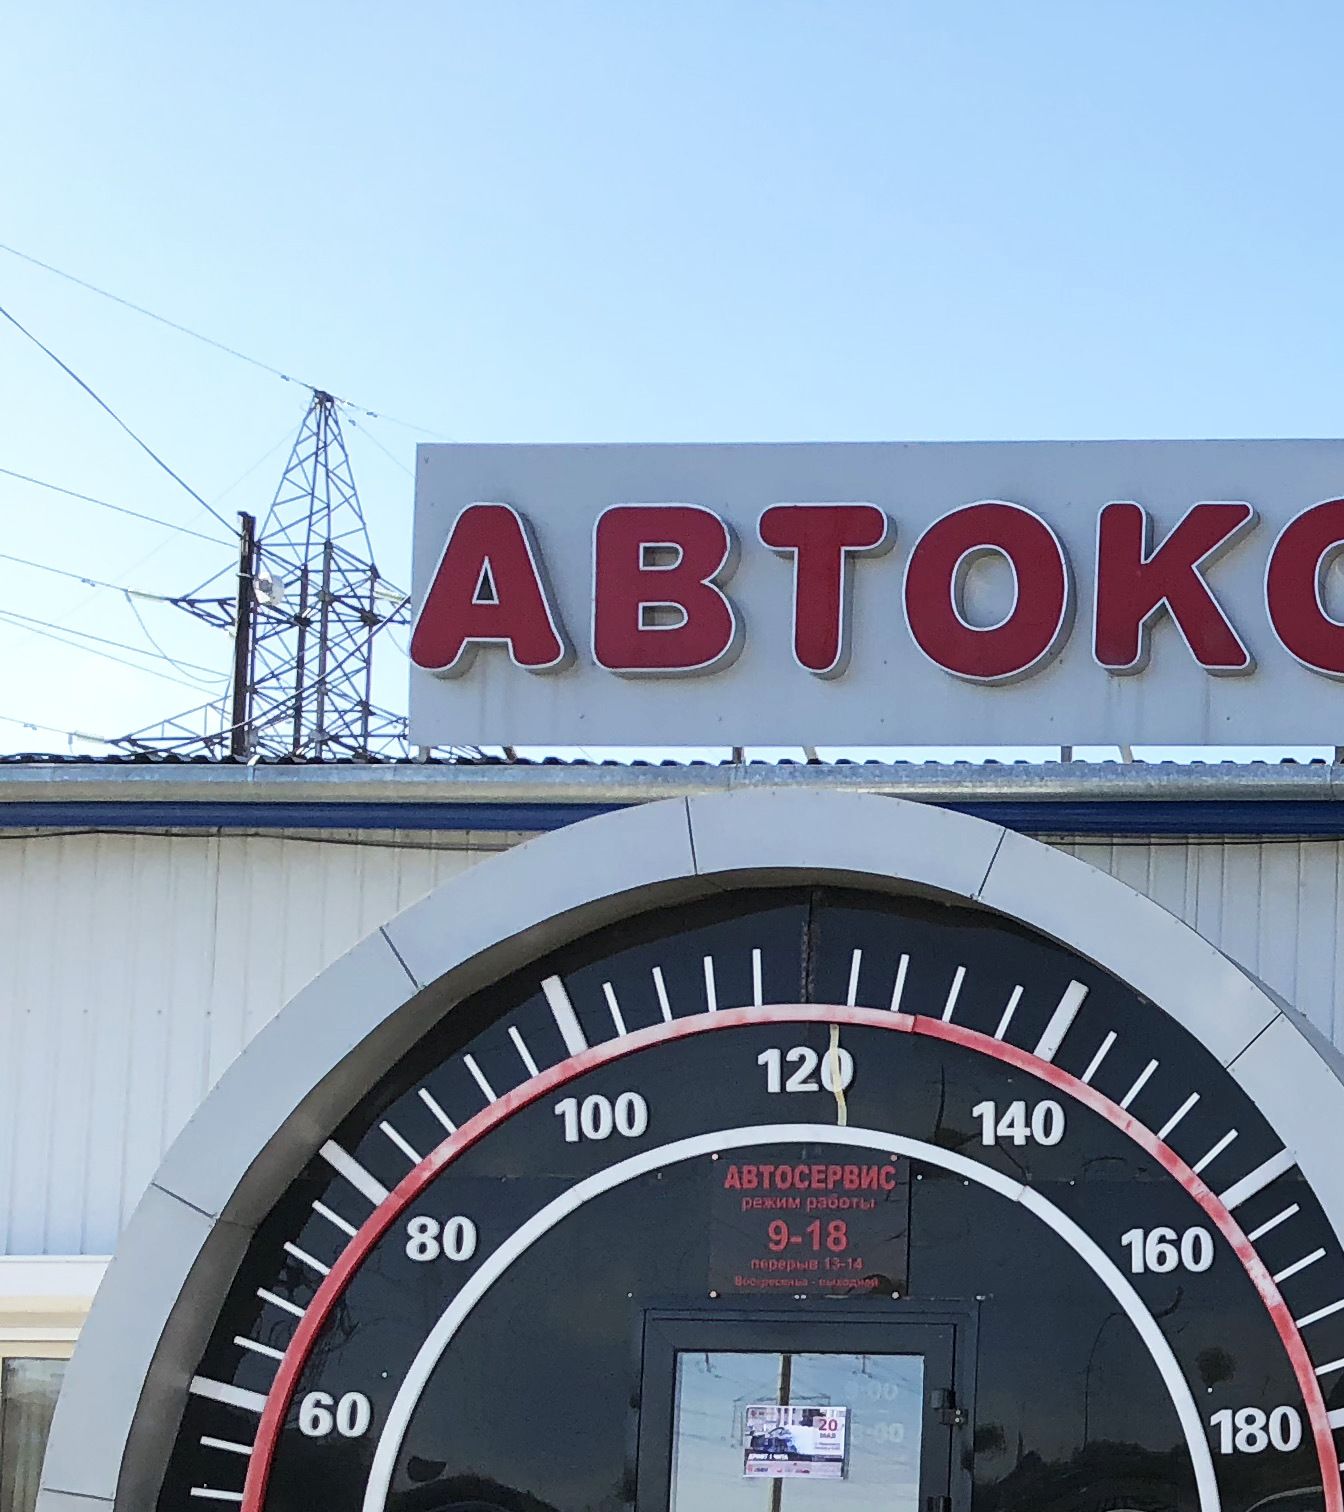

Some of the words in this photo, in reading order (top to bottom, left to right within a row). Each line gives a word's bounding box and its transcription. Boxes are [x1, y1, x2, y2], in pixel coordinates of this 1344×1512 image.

[757, 1047, 854, 1093] 120
[553, 1090, 649, 1143] 100
[972, 1099, 1066, 1147] 140
[724, 1165, 897, 1191] АВТОСЕРВИС
[742, 1197, 801, 1212] режим
[807, 1195, 876, 1212] работы
[405, 1215, 478, 1262] 80
[768, 1219, 850, 1252] 9-18
[1122, 1226, 1215, 1274] 160
[751, 1260, 819, 1272] перерыв
[825, 1258, 864, 1271] 13-14
[299, 1391, 371, 1437] 60
[818, 1419, 838, 1431] 20
[1210, 1405, 1304, 1455] 180
